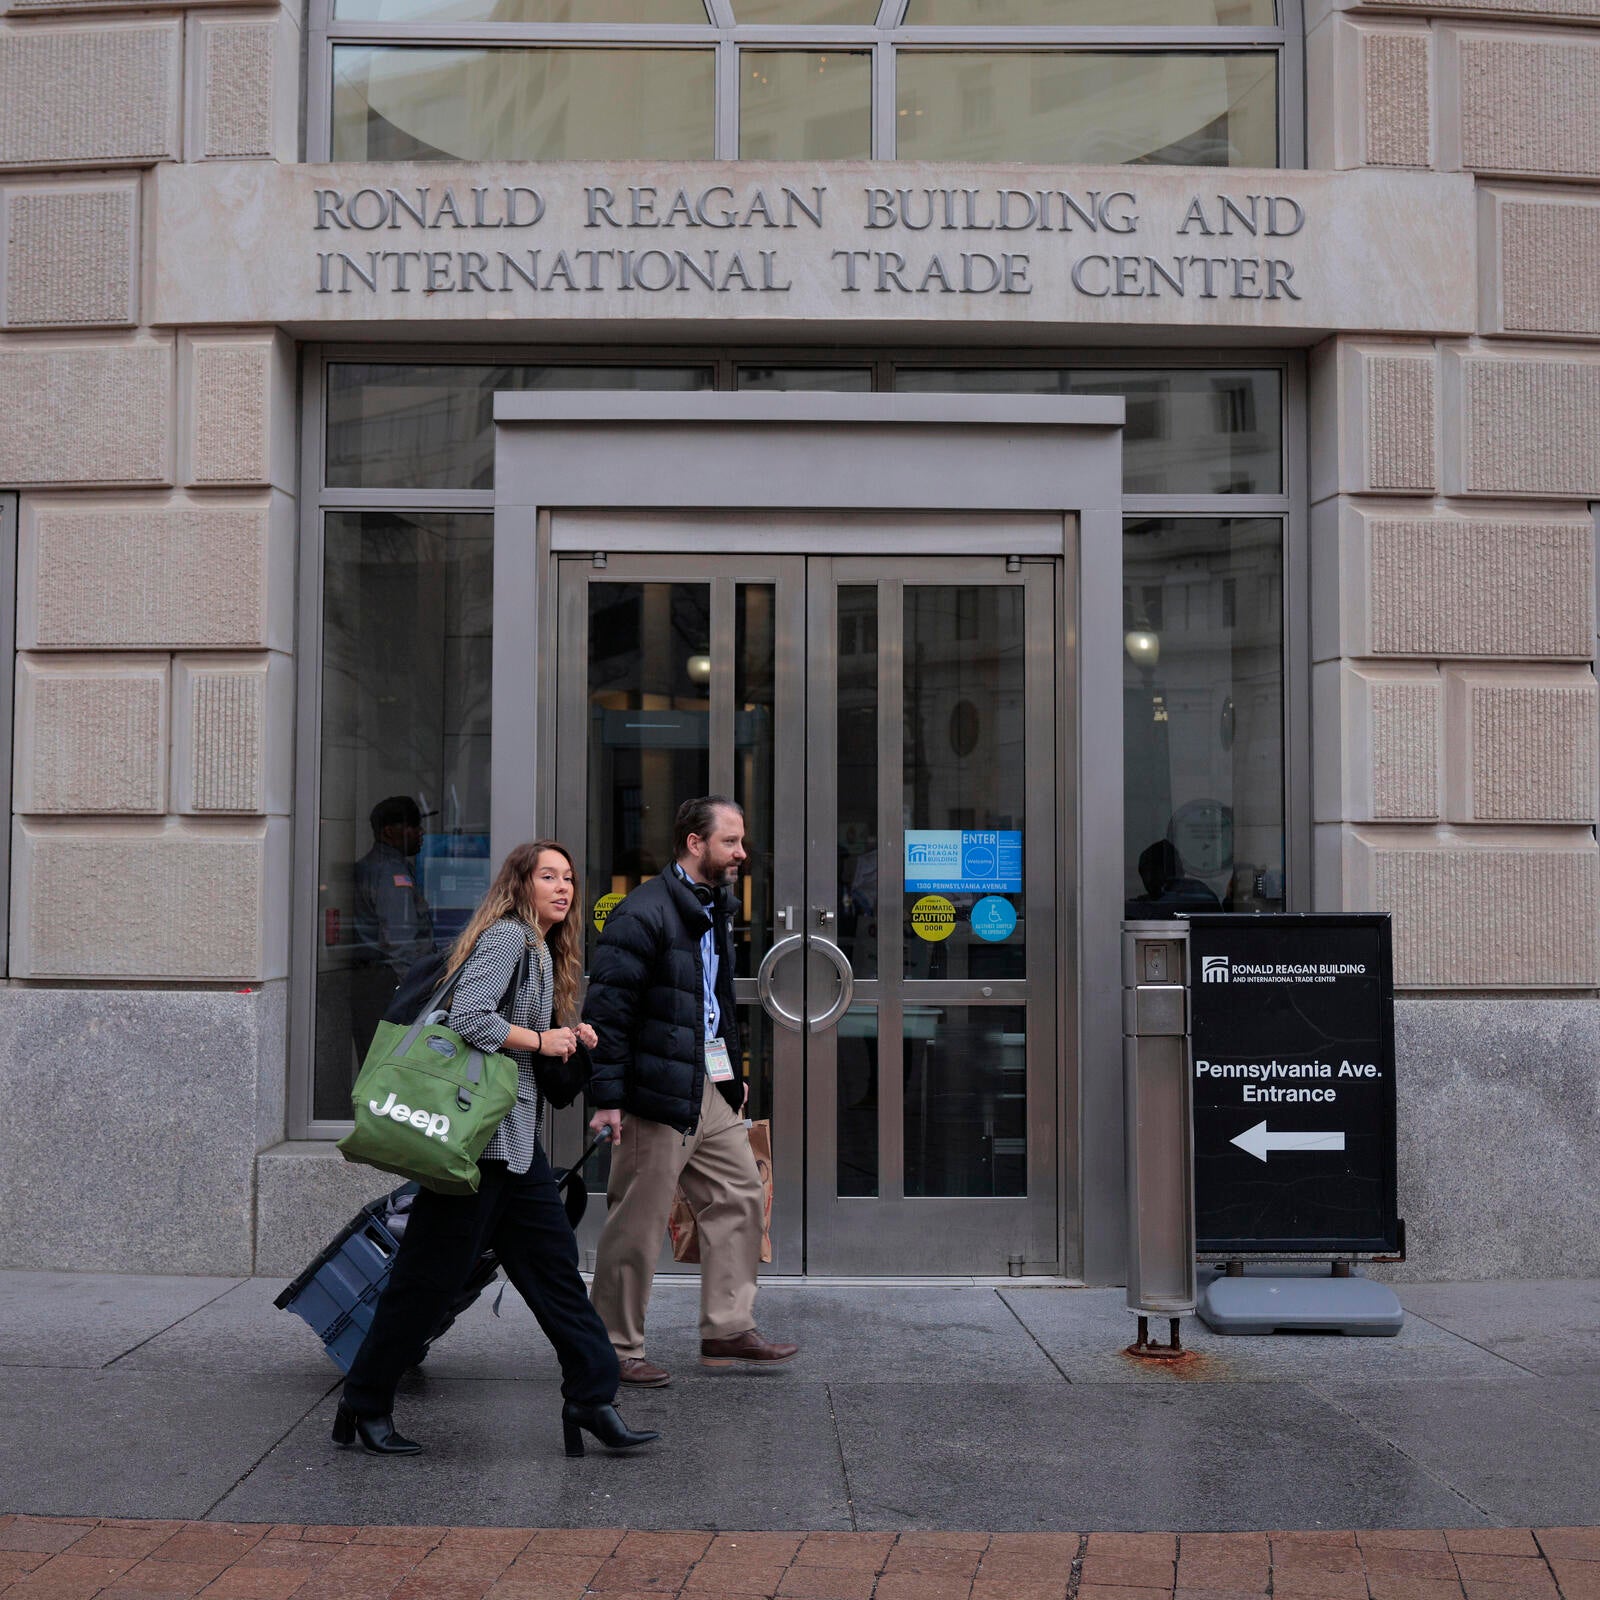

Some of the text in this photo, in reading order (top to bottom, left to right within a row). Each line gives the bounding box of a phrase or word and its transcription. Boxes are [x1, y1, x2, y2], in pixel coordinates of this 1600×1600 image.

[314, 185, 1306, 237] RONALD REAGAN BUILDING AND
[315, 248, 1303, 301] INTERNATIONAL TRADE CENTER
[962, 833, 996, 845] ENTER
[932, 882, 981, 890] PENNSYLVANIA
[982, 882, 1008, 890] AVENUE
[912, 913, 954, 922] CAUTION
[1231, 963, 1366, 974] RONALD REAGAN BUILDING
[1232, 975, 1337, 983] AND INTERNATIONAL TRADE CENTER
[1196, 1060, 1383, 1082] Pennsylvania Ave.
[1243, 1084, 1337, 1102] Entrance
[369, 1092, 450, 1138] Jeep
